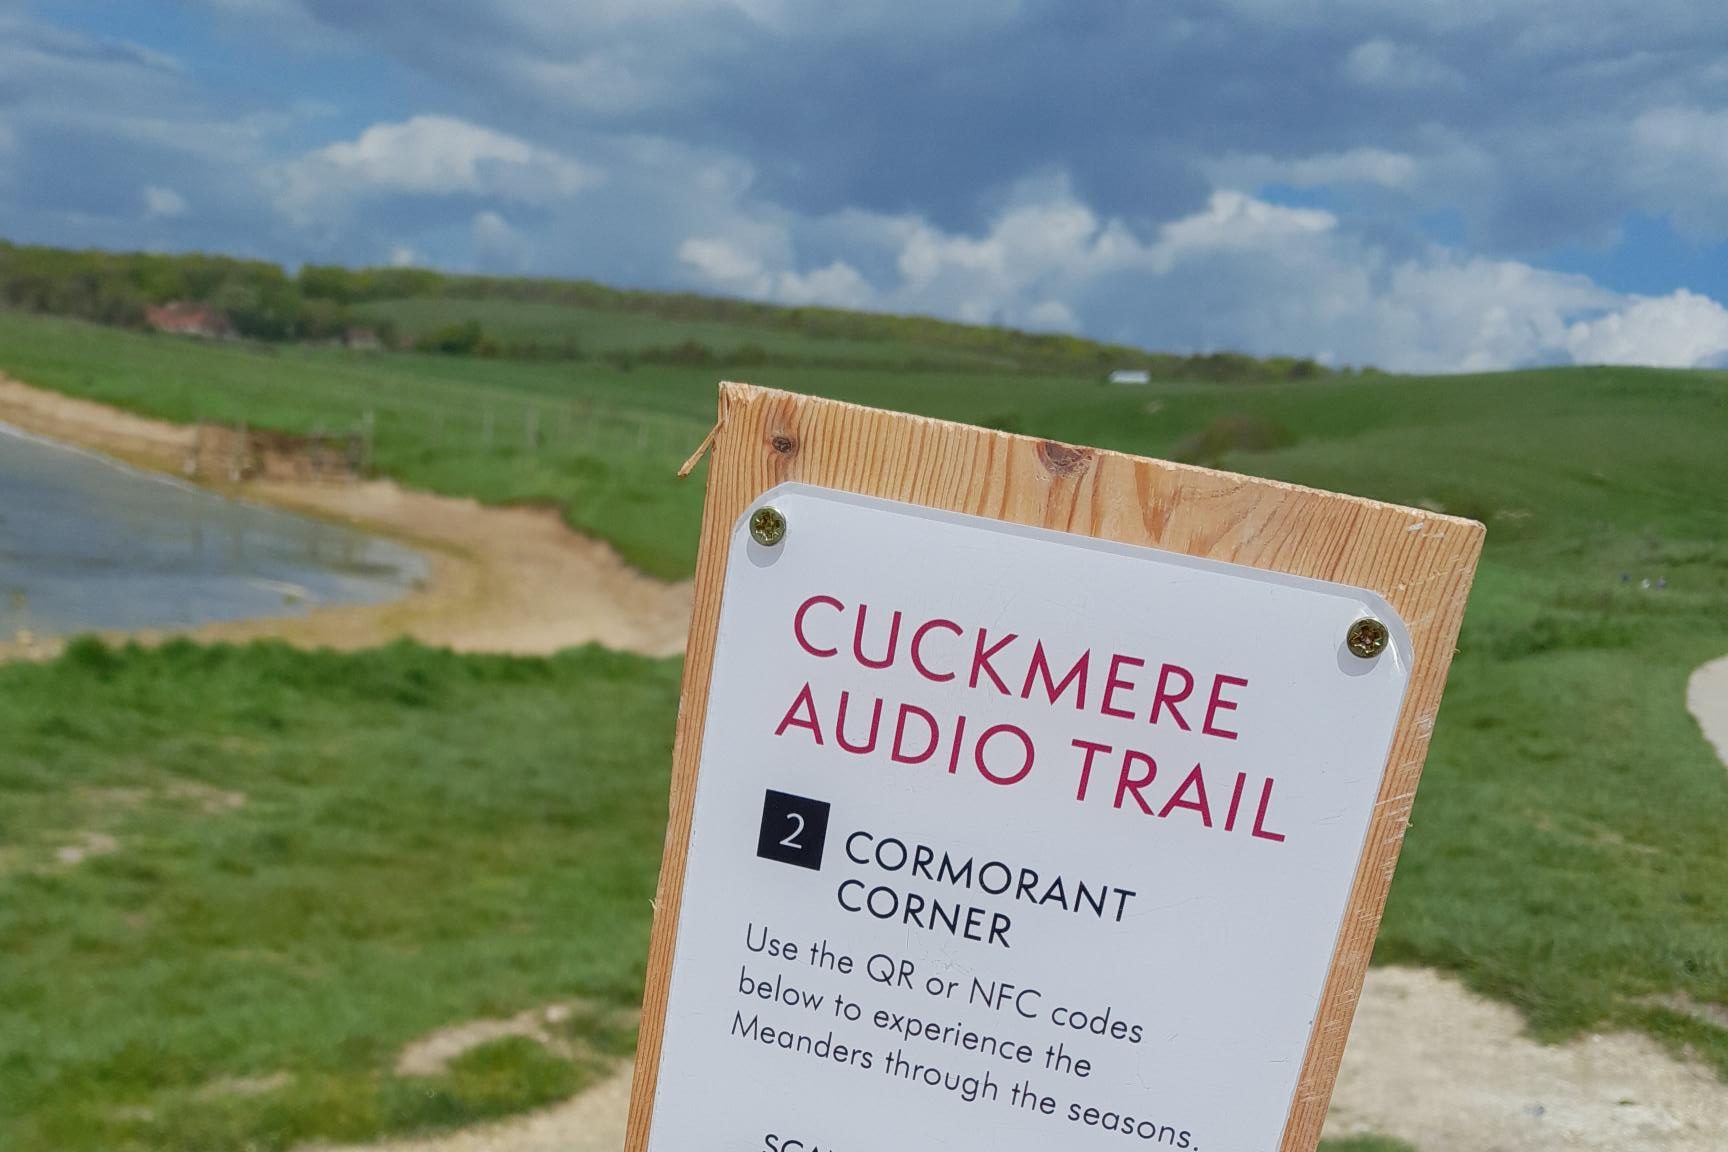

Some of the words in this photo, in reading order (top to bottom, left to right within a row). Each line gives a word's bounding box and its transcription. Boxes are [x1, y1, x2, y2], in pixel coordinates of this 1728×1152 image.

[793, 595, 1249, 741] CUCKMERE
[774, 681, 1035, 786] AUDIO
[1071, 738, 1286, 843] TRAIL
[779, 812, 805, 849] 2
[845, 830, 1137, 922] CORMORANT
[837, 878, 1012, 949] CORNER
[738, 965, 824, 1012] below
[834, 994, 862, 1022] to
[873, 1010, 1033, 1064] experience
[1045, 1042, 1092, 1078] the
[746, 922, 798, 961] Use
[810, 939, 854, 975] the
[866, 953, 915, 990] QR
[925, 977, 959, 999] or
[969, 976, 1042, 1019] NFC
[1051, 1006, 1144, 1044] codes
[731, 1009, 873, 1070] Meanders
[885, 1048, 998, 1103] through
[1011, 1080, 1056, 1115] the
[1067, 1103, 1199, 1152] seasons.
